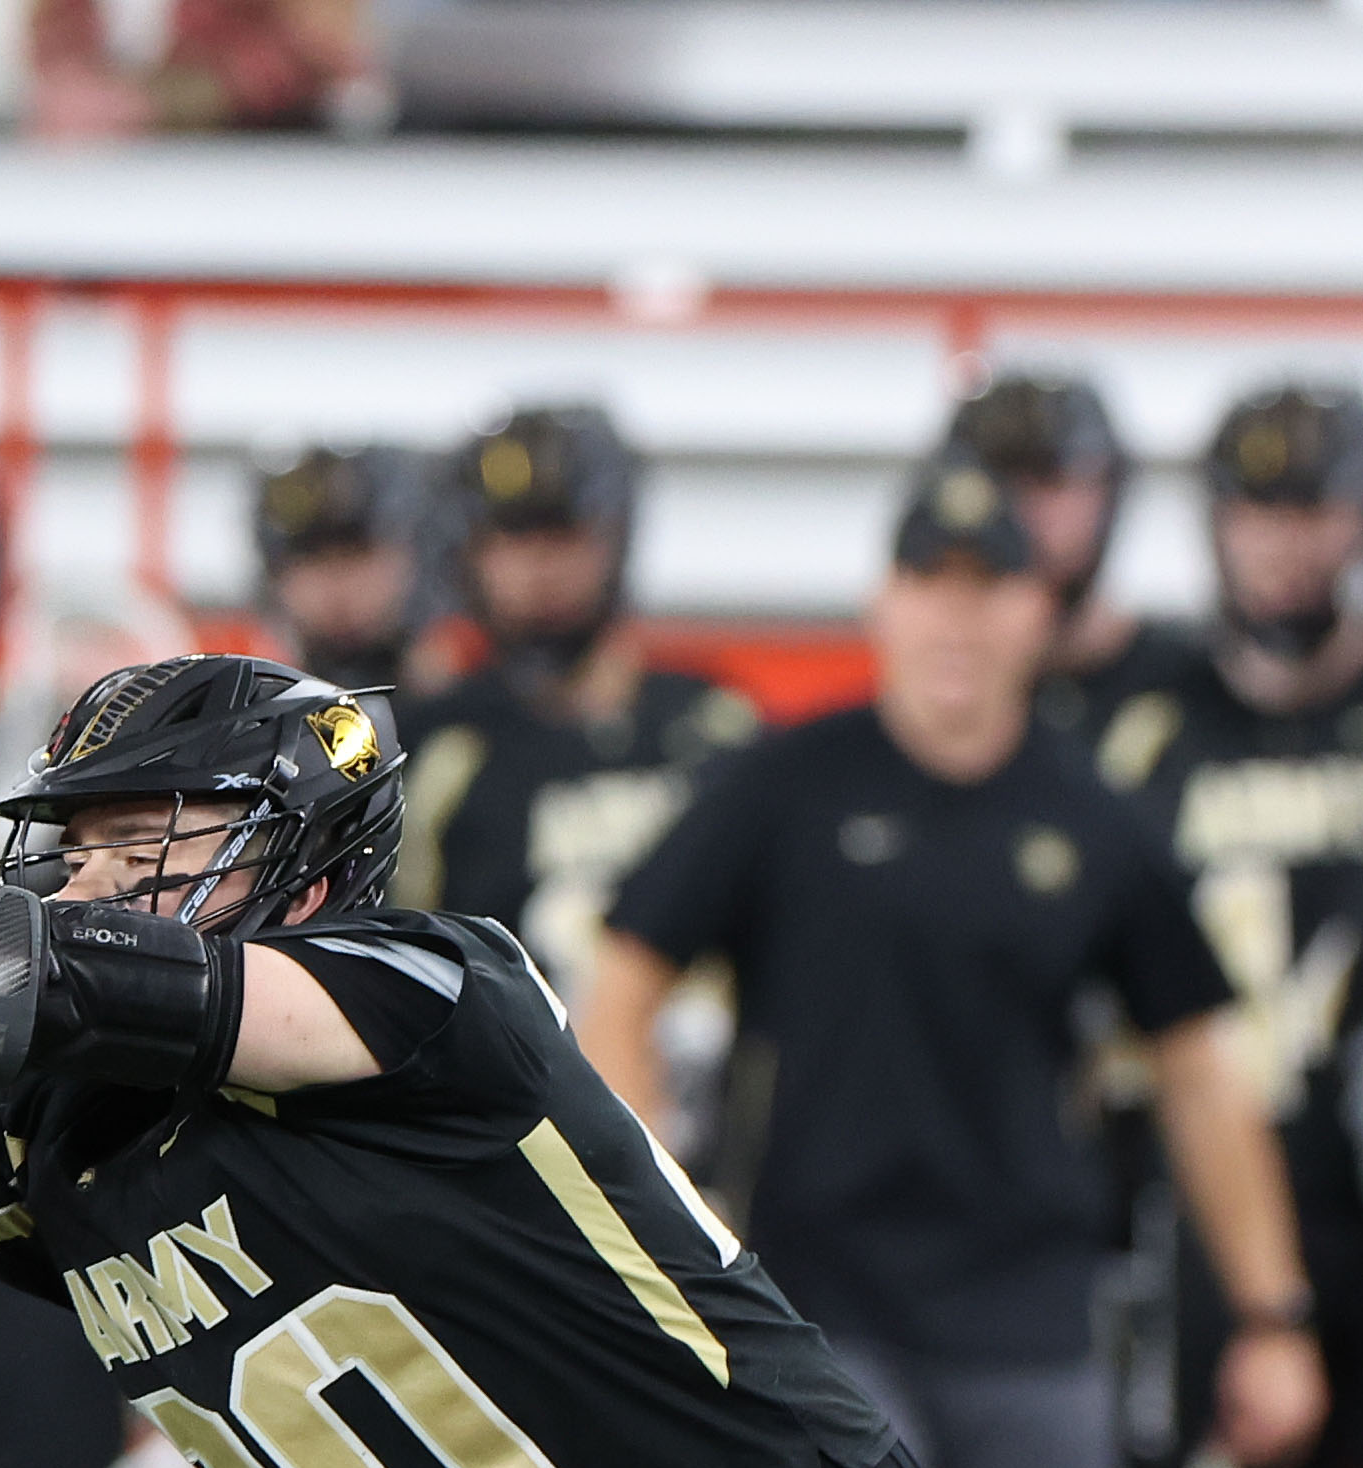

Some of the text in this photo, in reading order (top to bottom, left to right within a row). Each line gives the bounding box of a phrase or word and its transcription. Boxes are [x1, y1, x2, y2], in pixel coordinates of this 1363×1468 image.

[179, 798, 272, 925] cascade
[72, 926, 138, 947] EPOCH
[63, 1193, 274, 1372] ARMY
